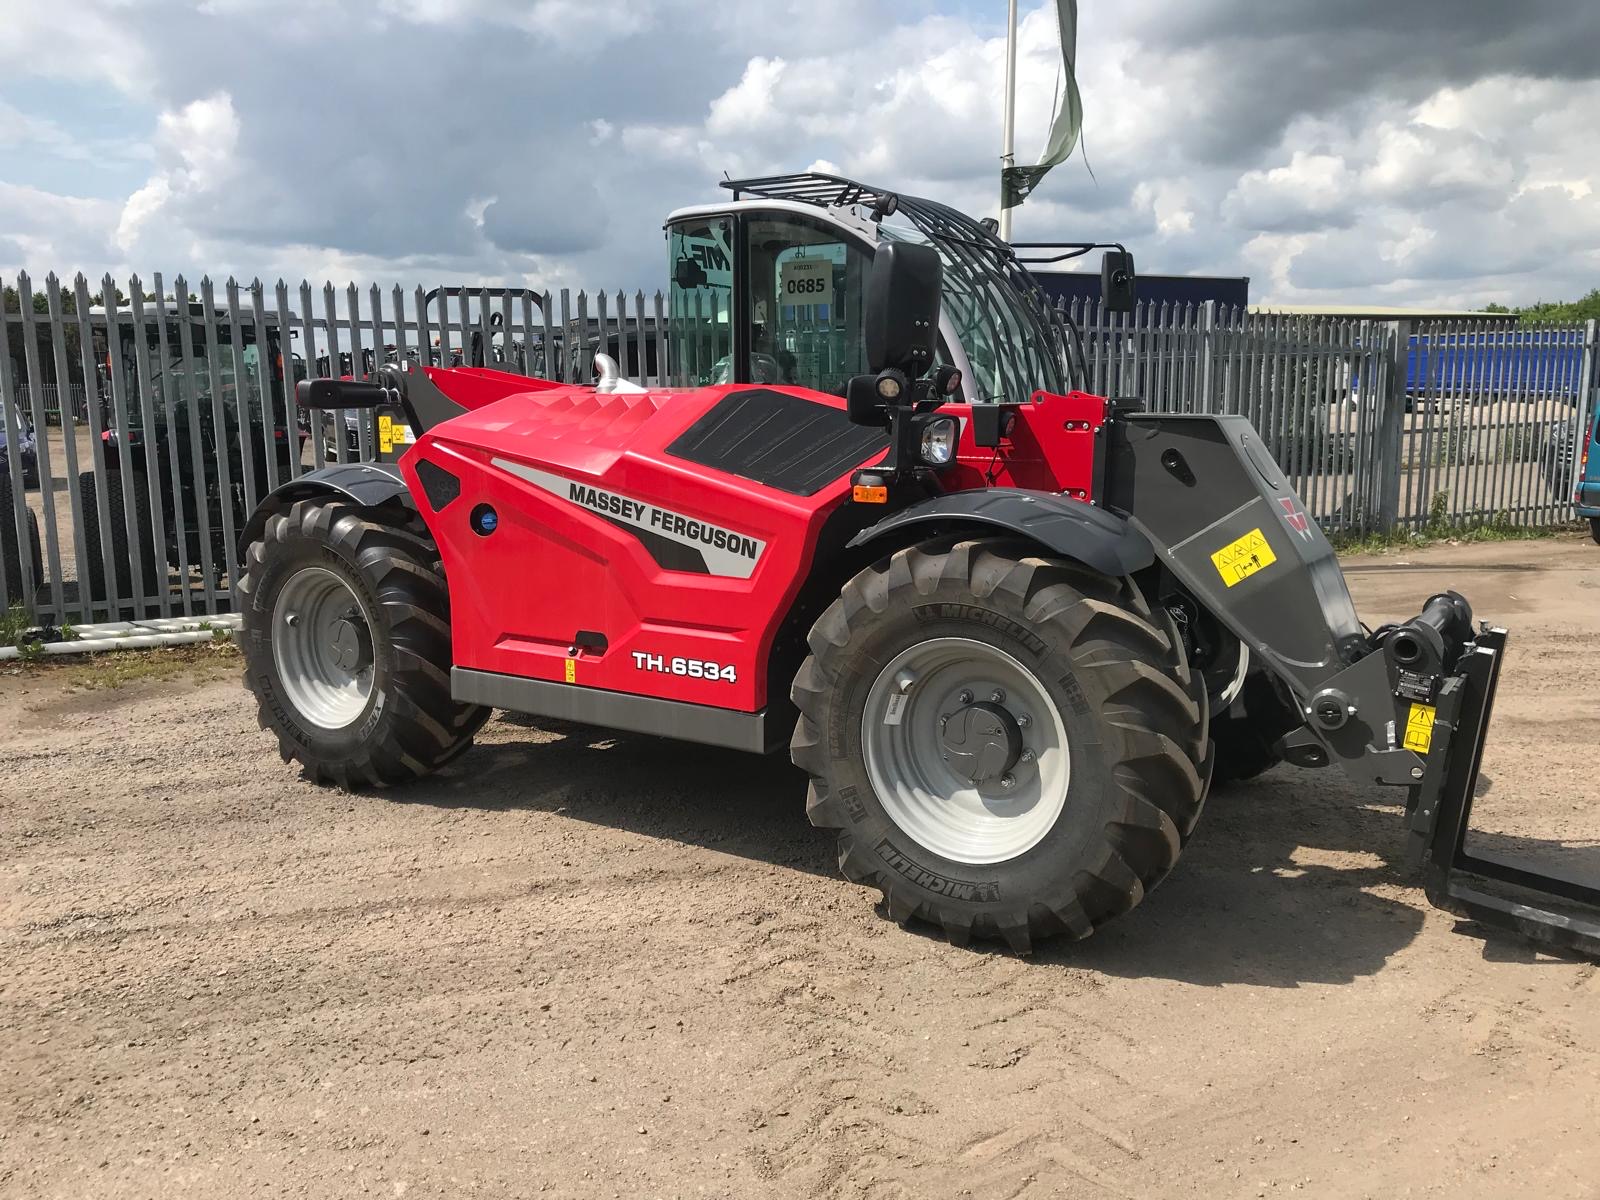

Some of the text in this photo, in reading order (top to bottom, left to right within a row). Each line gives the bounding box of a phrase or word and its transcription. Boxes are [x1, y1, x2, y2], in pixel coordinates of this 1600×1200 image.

[787, 278, 825, 294] 0685
[569, 483, 758, 559] MASSEY FERGUSON
[940, 604, 1045, 652] MICHELIN
[632, 652, 737, 683] TH.6534
[880, 844, 976, 900] MICHELIN
